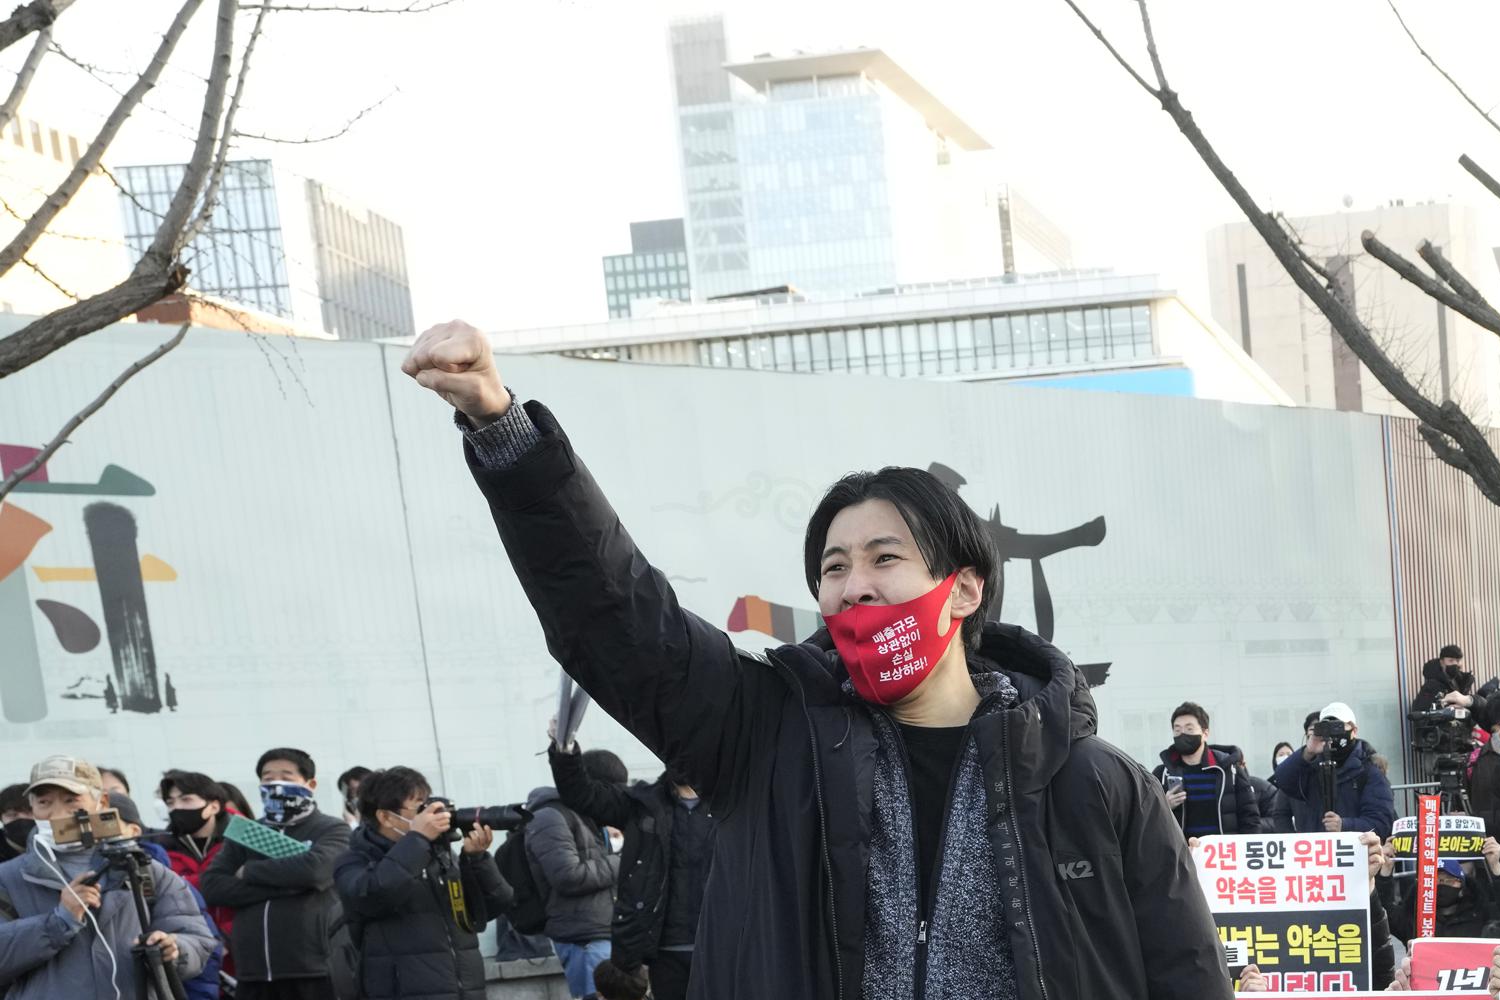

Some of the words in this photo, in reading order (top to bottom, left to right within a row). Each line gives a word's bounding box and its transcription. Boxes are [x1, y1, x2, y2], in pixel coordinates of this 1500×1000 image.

[872, 616, 918, 643] 매출규모
[878, 629, 921, 655] 상관없이
[880, 656, 929, 682] 보상하라!
[892, 648, 914, 666] 손실
[1424, 799, 1437, 862] 매출피해액
[1204, 840, 1237, 871] 2년
[1245, 839, 1286, 871] 동안
[1293, 838, 1355, 869] 우리는
[1058, 860, 1095, 881] K2
[1216, 875, 1277, 905] 약속을
[1285, 874, 1347, 903] 지켰고
[1422, 865, 1437, 914] 백퍼센트
[1287, 923, 1362, 964] 약속을
